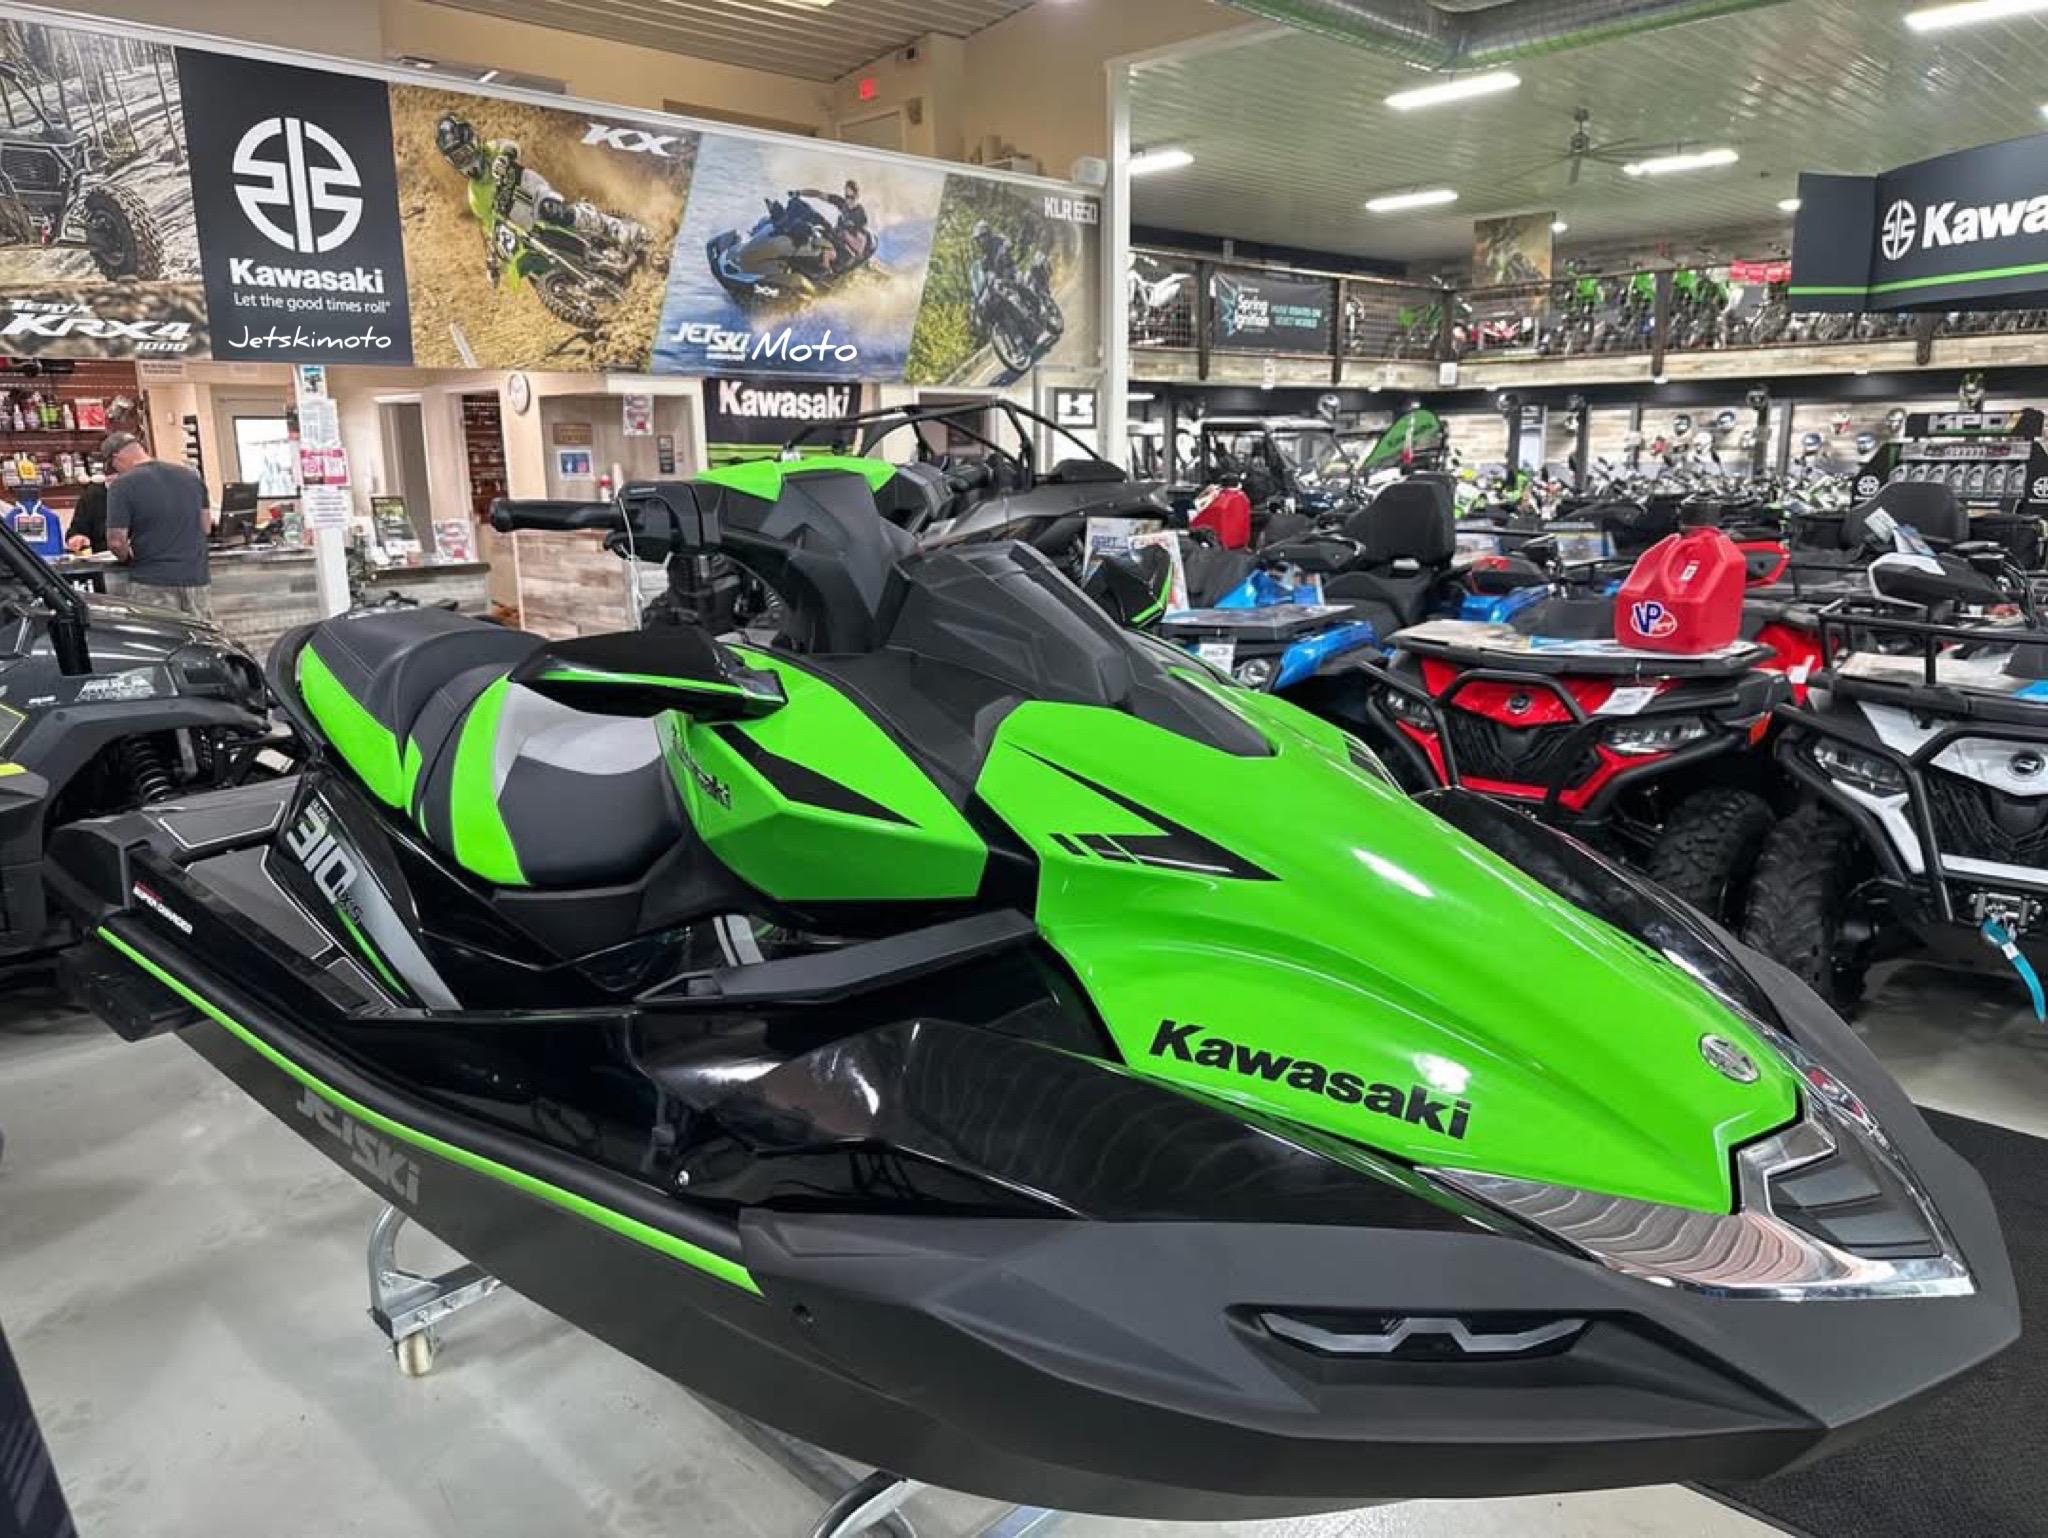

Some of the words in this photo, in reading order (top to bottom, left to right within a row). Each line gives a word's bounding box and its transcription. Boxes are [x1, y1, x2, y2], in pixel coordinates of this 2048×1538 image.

[580, 122, 679, 157] KX
[1921, 195, 2048, 249] Kawa
[229, 257, 385, 294] Kawasaki
[233, 292, 258, 307] Let
[260, 293, 284, 309] the
[286, 296, 324, 312] good
[326, 298, 362, 313] times
[719, 379, 850, 420] Kawasaki
[286, 805, 358, 905] 310
[1148, 1019, 1473, 1140] Kawasaki
